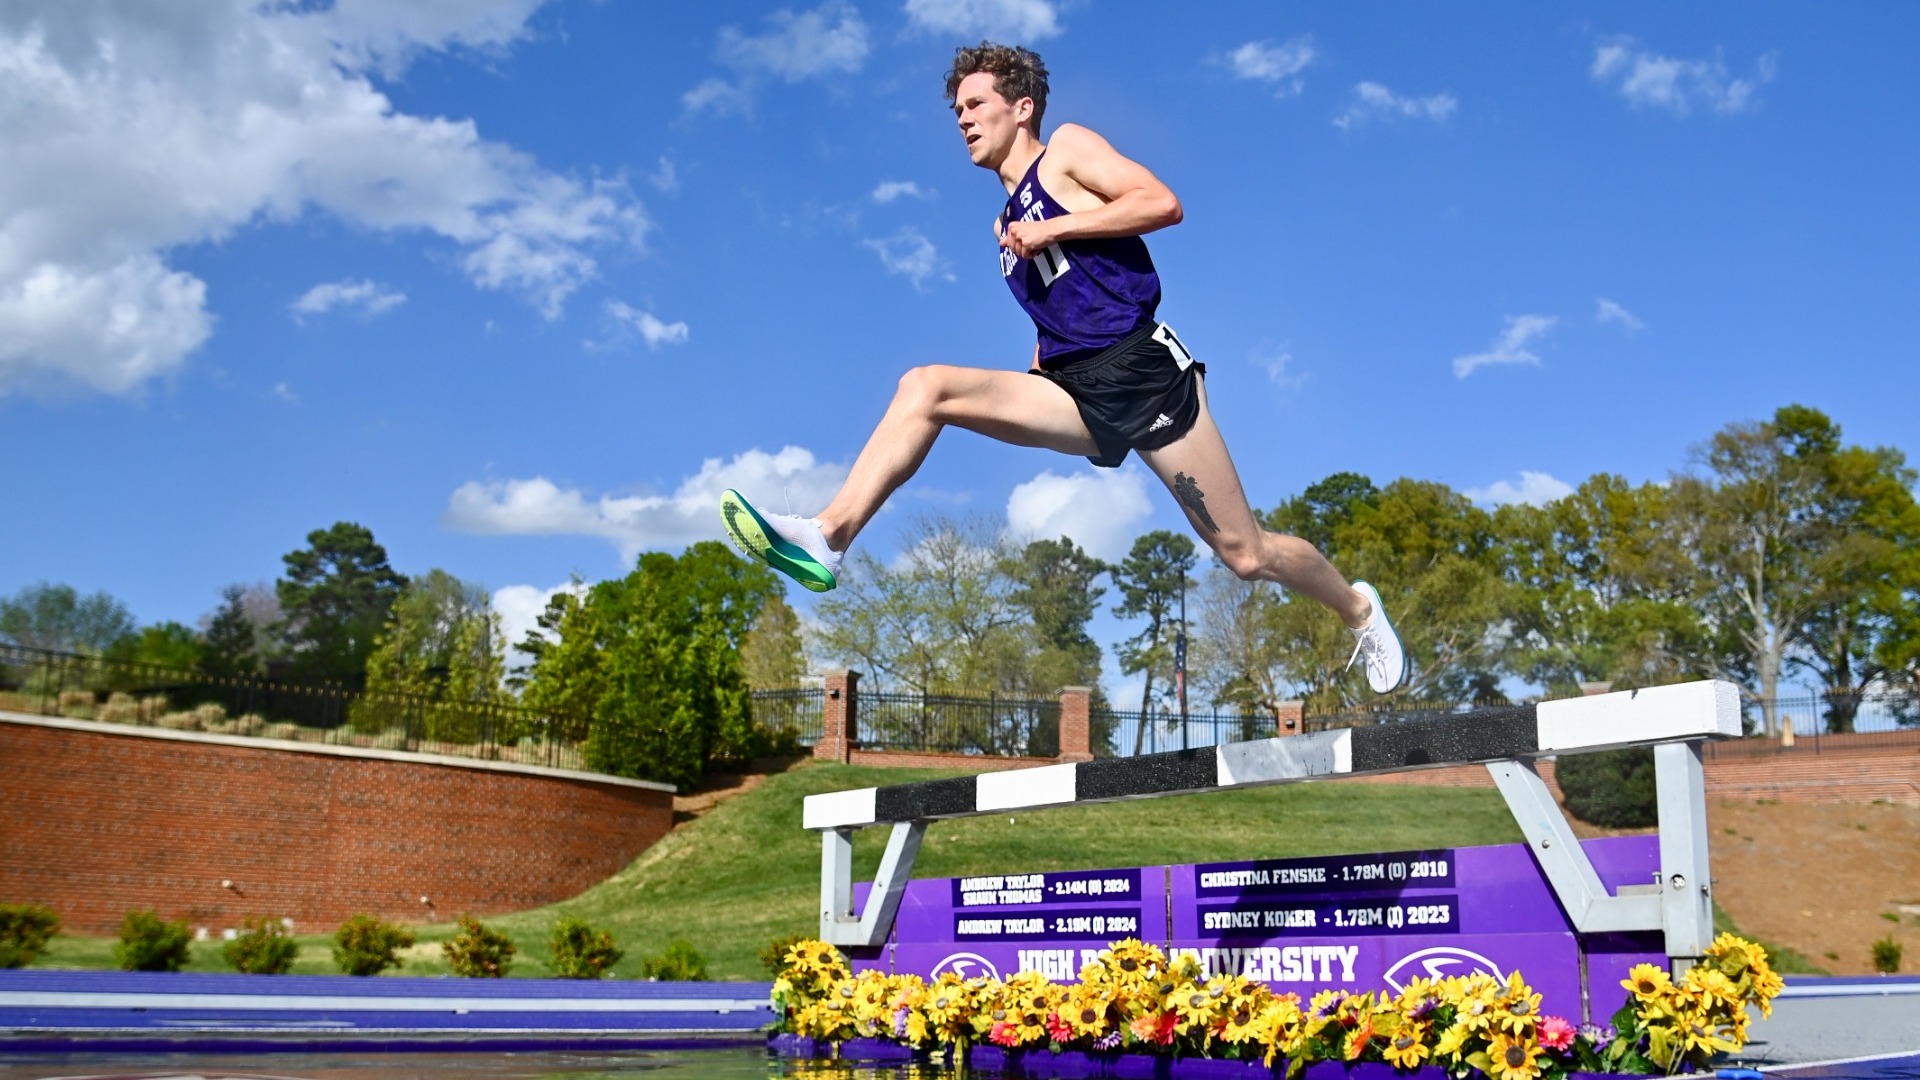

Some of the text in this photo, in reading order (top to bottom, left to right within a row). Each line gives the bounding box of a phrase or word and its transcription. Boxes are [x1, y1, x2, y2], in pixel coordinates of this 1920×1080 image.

[1162, 325, 1191, 360] 1
[960, 874, 1045, 892] ANDREW TAYLOR
[1200, 869, 1270, 888] CHRISTINA
[1272, 867, 1326, 884] FENSKE
[1342, 864, 1385, 881] 1.78M
[1410, 861, 1448, 878] 2010
[962, 888, 1042, 906] SHAUN THOMAS
[1055, 880, 1087, 895] 2.14M
[1103, 878, 1130, 893] 2024
[957, 919, 1003, 935] ANDREW
[1003, 918, 1045, 934] TAYLOR
[1106, 917, 1137, 932] 2024
[1204, 911, 1260, 929] SYDNEY
[1263, 909, 1317, 927] KOKER
[1334, 907, 1383, 927] 1.78M
[1407, 905, 1450, 925] 2023
[1018, 949, 1075, 981] HIGH
